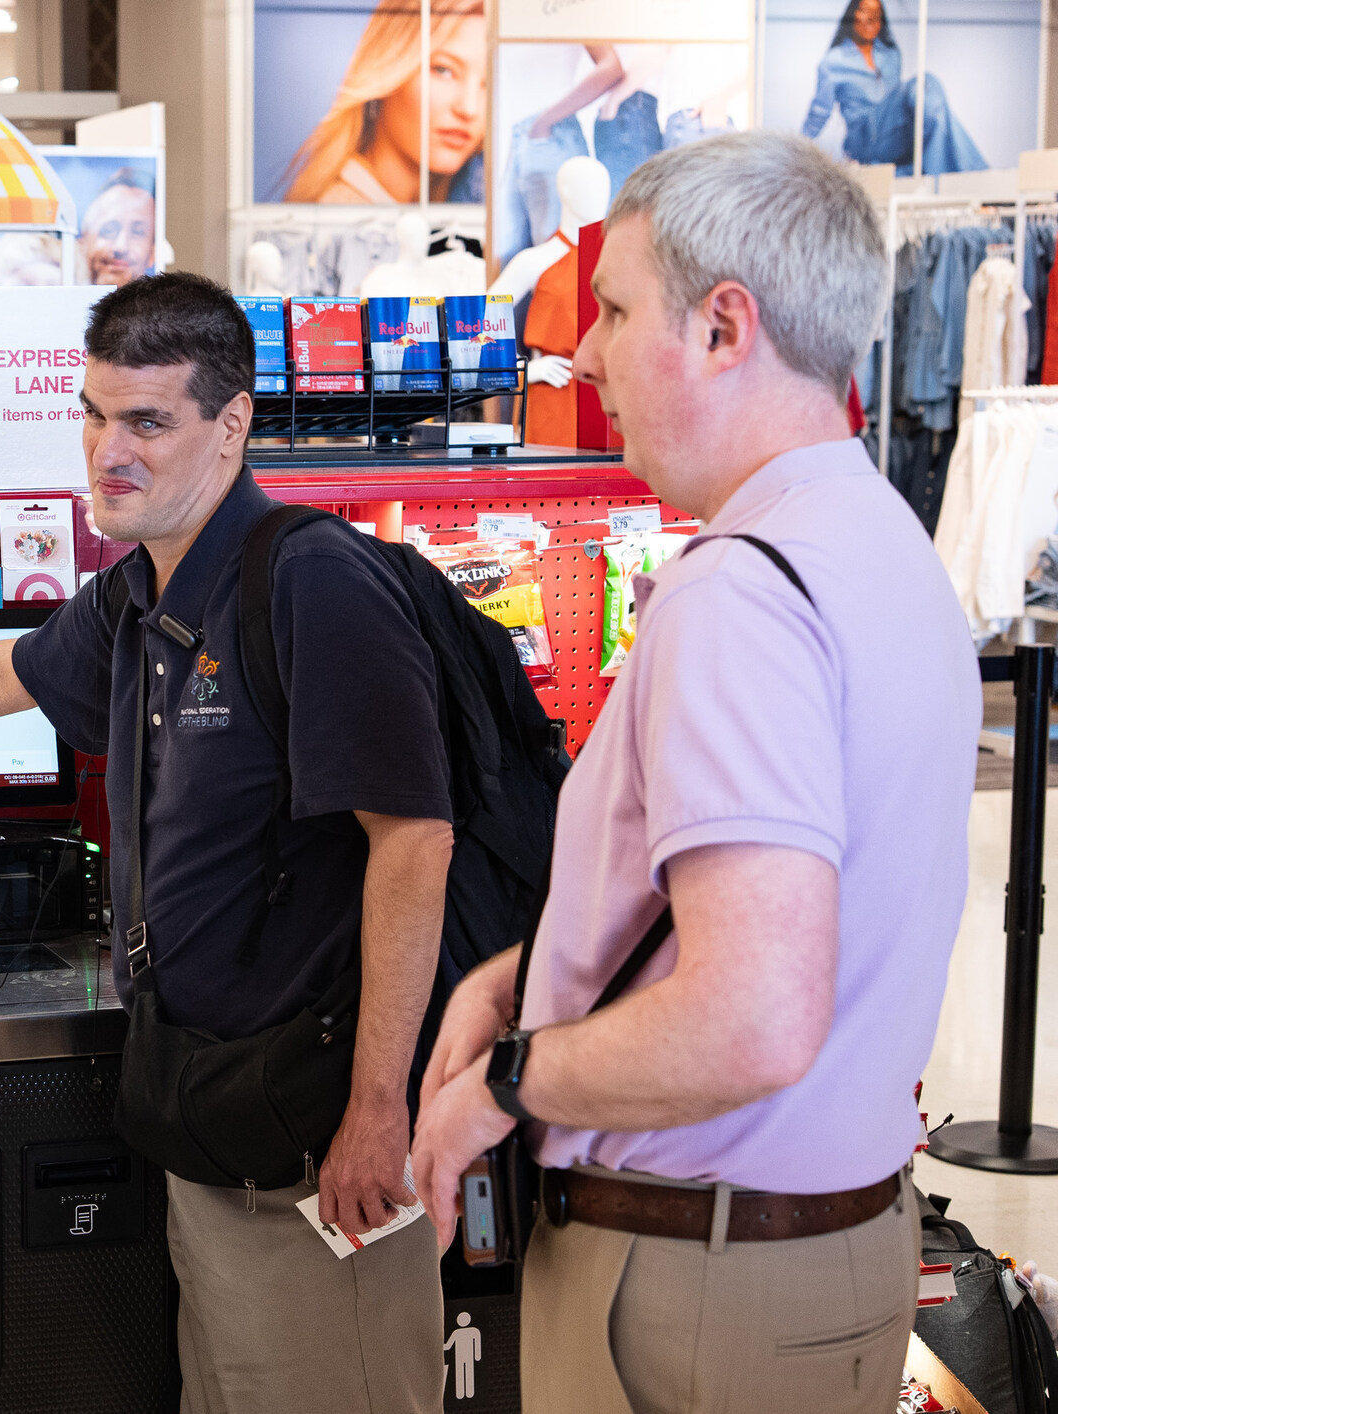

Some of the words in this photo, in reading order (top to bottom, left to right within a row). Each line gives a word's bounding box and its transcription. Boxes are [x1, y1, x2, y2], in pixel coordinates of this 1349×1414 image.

[378, 322, 404, 336] Red
[406, 321, 430, 335] Bull
[455, 320, 481, 334] Red
[482, 318, 507, 332] Bull
[254, 329, 284, 341] BLUE
[296, 340, 310, 362] Bull
[15, 376, 74, 394] LANE
[3, 408, 43, 421] items
[48, 410, 63, 421] or
[25, 513, 56, 521] GiftCard
[482, 524, 499, 532] 3.79
[613, 520, 628, 529] 3.79
[447, 568, 473, 583] ACK
[479, 600, 510, 612] JERKY
[201, 715, 229, 726] BLIND
[12, 759, 25, 767] Pay
